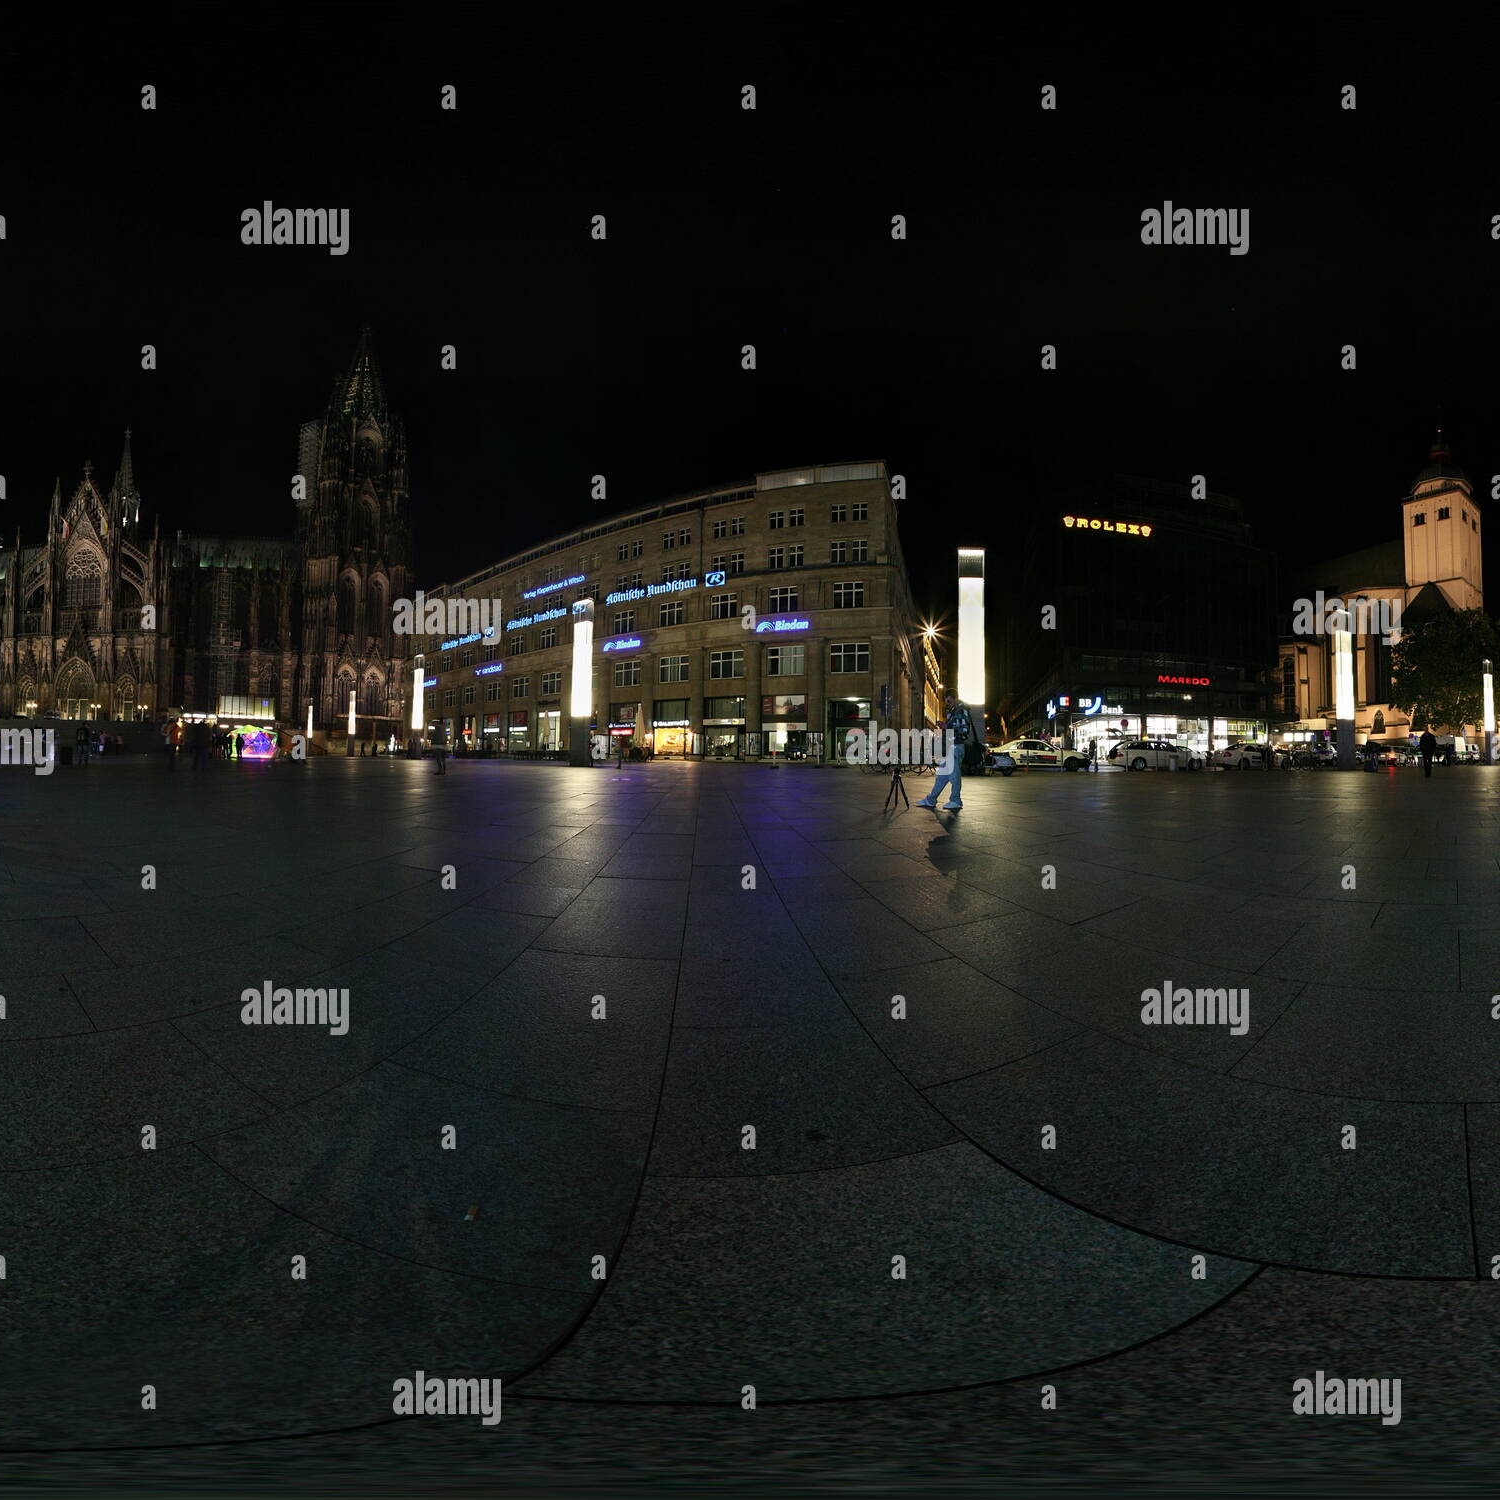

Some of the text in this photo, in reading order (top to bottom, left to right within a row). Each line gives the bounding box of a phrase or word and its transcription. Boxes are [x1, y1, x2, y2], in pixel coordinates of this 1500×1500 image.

[1076, 517, 1140, 535] ROLEX
[774, 618, 809, 632] Bindan
[1157, 675, 1211, 686] MAREDO
[1078, 698, 1092, 708] BB
[1100, 704, 1124, 715] Bank
